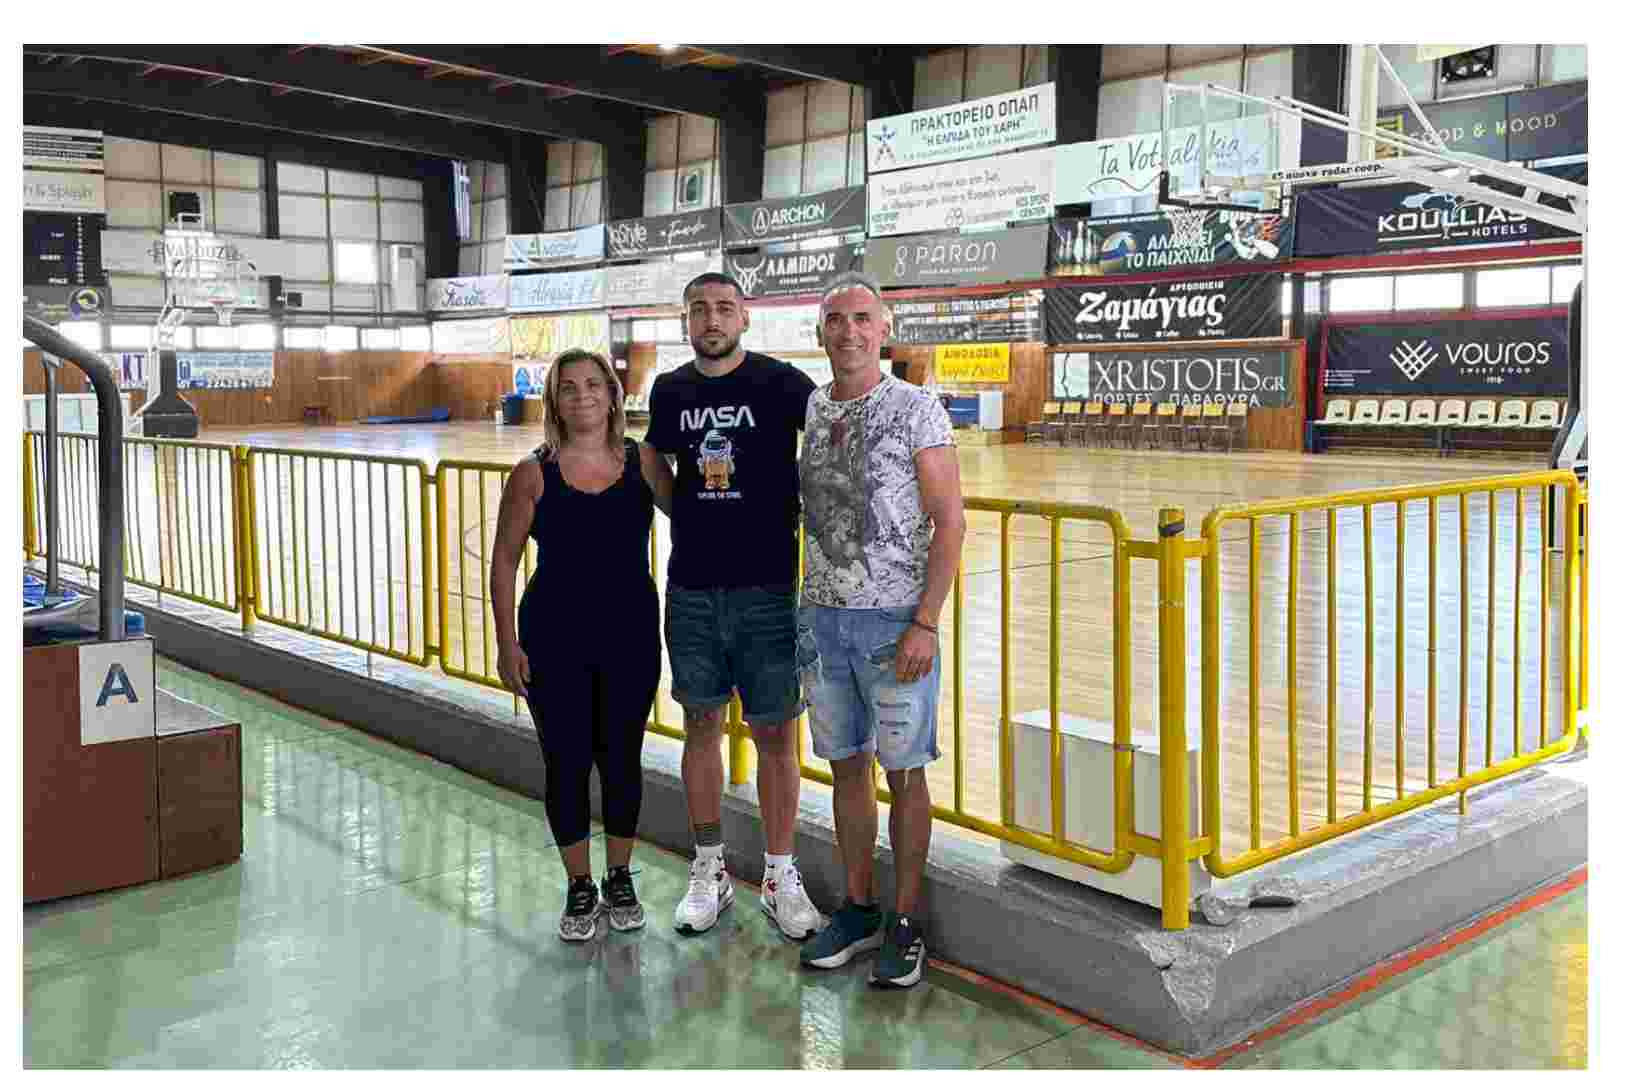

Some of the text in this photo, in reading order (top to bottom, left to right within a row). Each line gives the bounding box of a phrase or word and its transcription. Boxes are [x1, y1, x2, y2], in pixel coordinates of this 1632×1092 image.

[911, 94, 1038, 134] ΠΡΑΚΤΟΡΕΙΟ ΟΠΑΠ
[771, 203, 826, 225] ARCHON
[1472, 224, 1528, 237] HOTELS
[766, 253, 836, 276] ΛΑΜΠΡΟΣ
[1075, 287, 1226, 330] Ζαμάγιας
[680, 405, 756, 431] NASA
